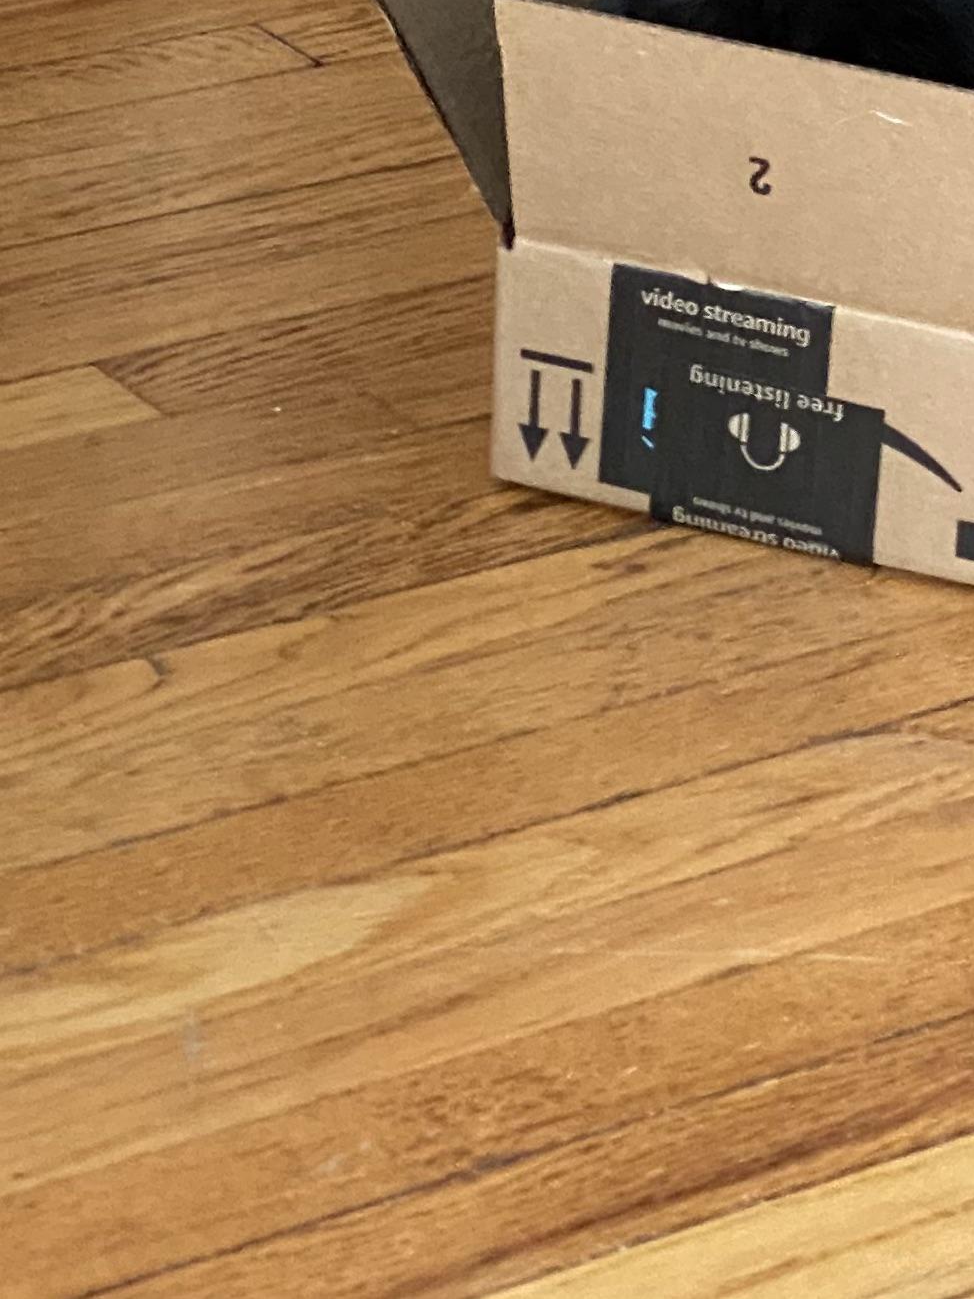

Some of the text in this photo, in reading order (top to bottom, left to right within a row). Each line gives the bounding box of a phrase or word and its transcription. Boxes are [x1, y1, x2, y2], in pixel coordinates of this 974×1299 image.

[748, 156, 773, 195] 2
[640, 287, 811, 348] video streaming
[689, 363, 845, 423] free listening
[672, 505, 780, 547] streaming
